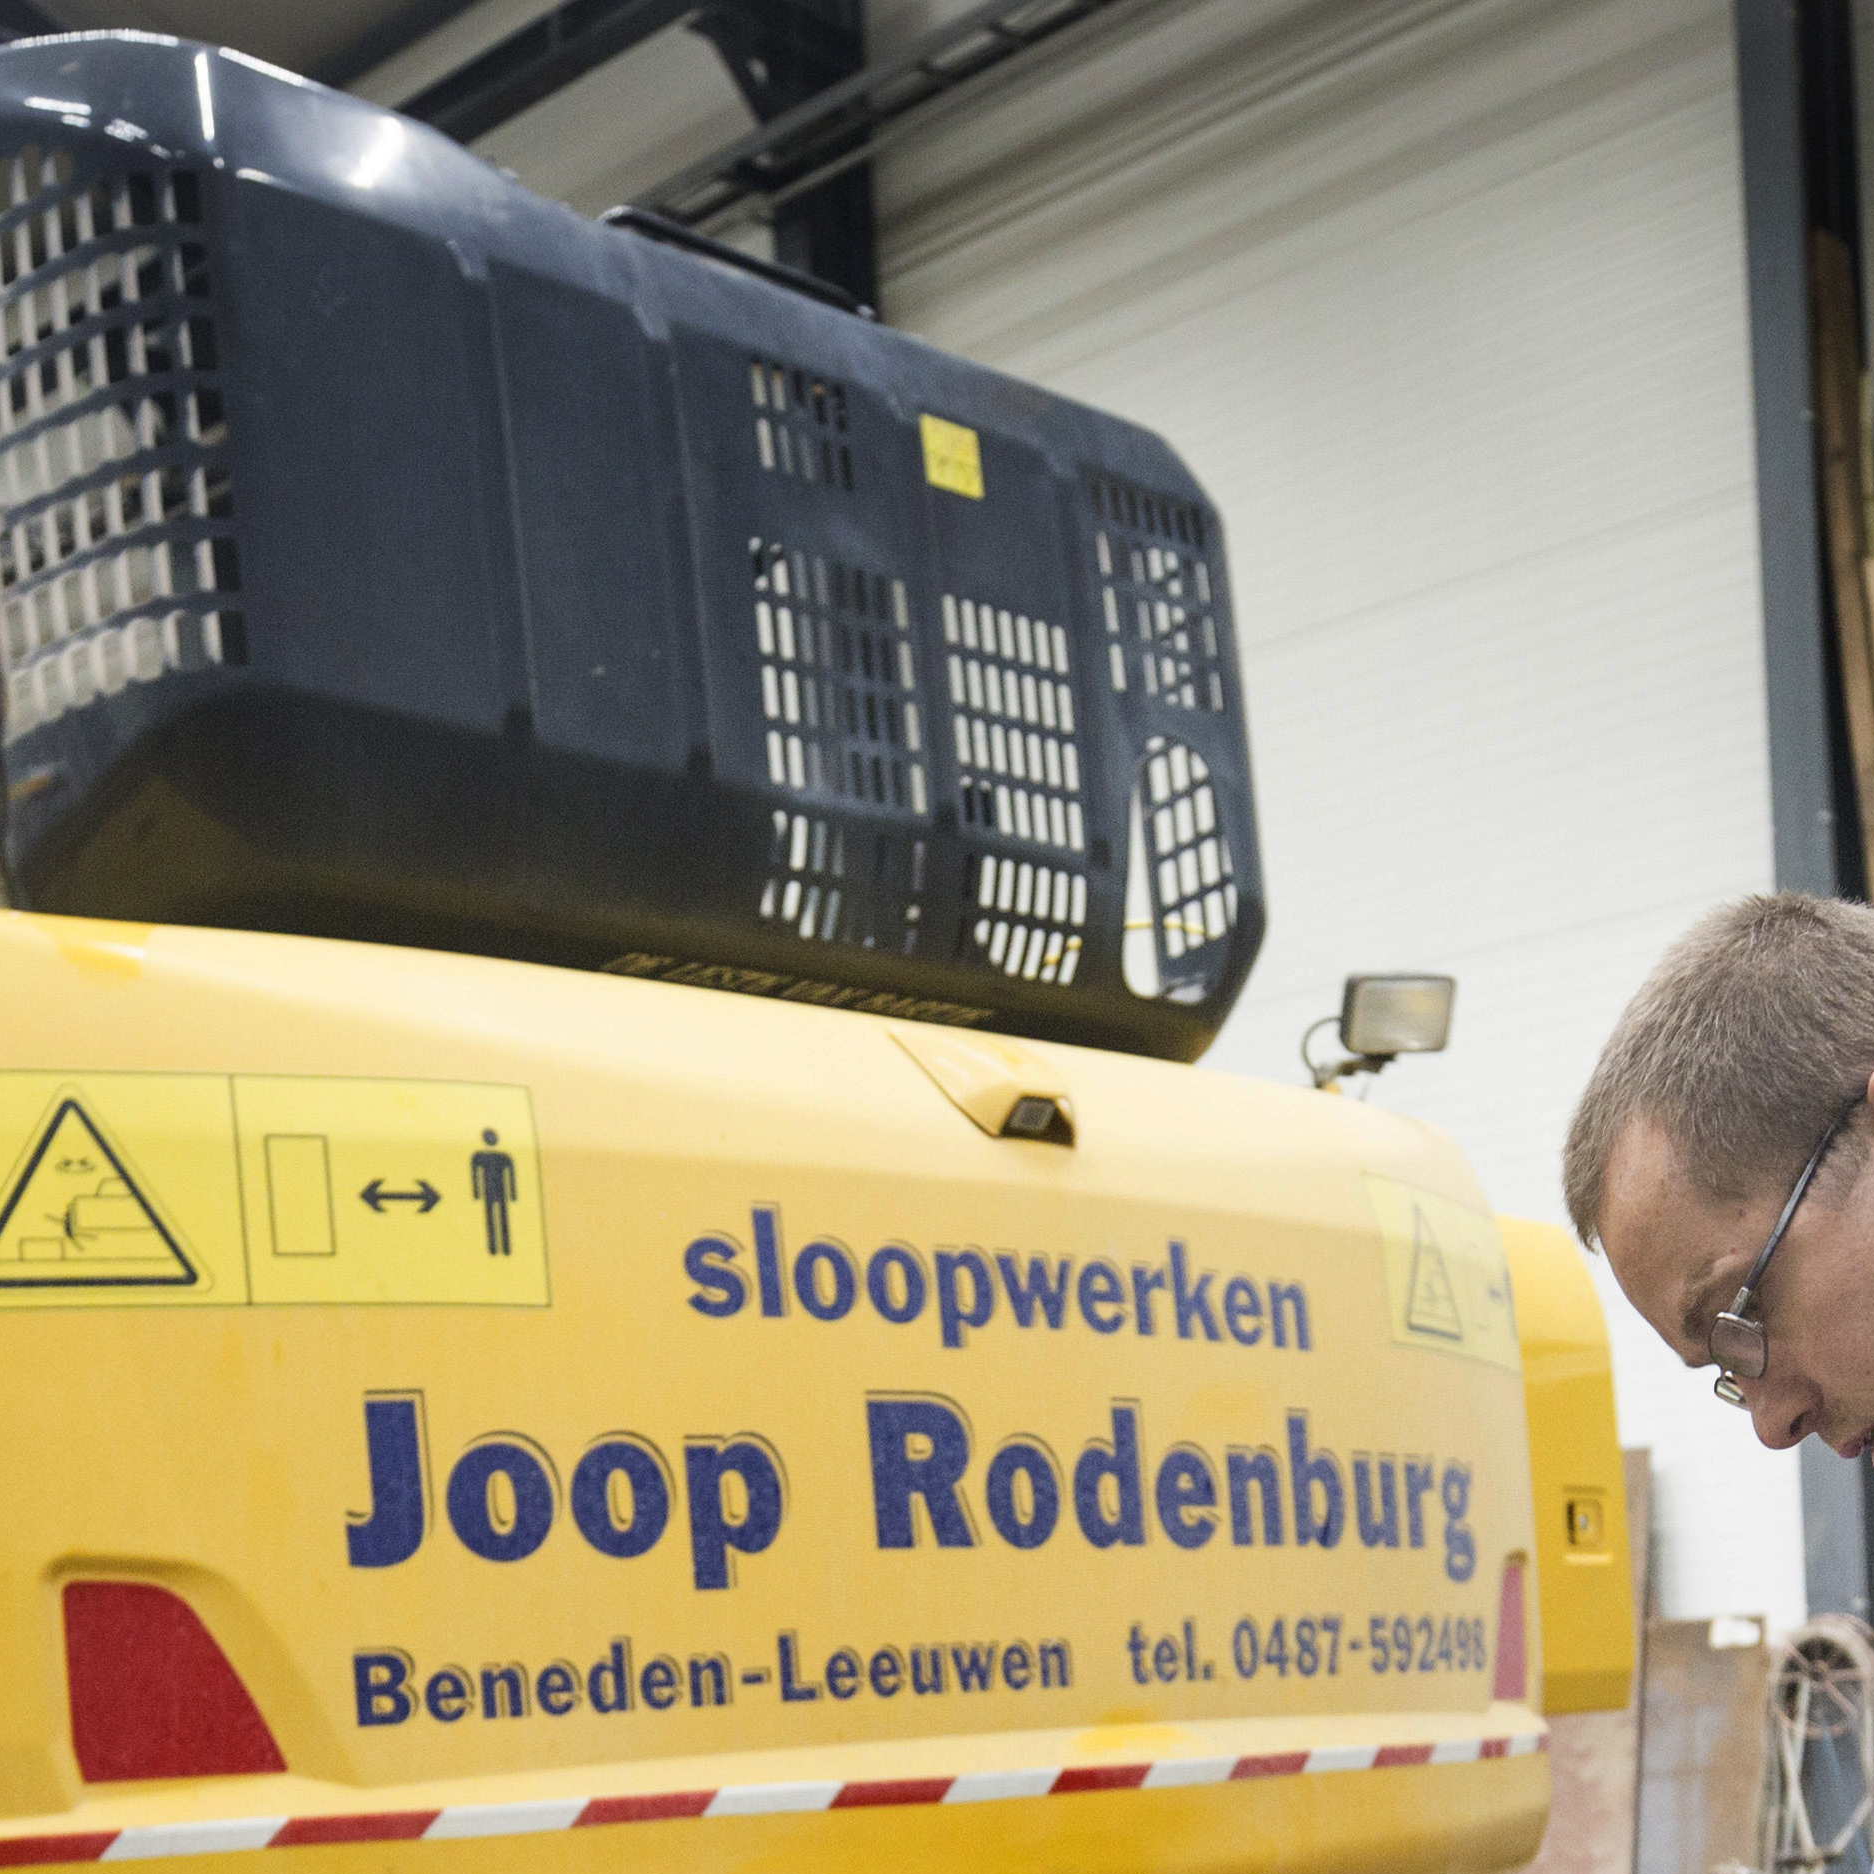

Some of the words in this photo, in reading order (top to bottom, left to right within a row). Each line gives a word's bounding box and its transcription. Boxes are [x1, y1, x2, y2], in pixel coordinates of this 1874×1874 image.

[683, 1201, 1314, 1351] sloopwerken
[345, 1389, 791, 1590] Joop
[864, 1390, 1477, 1582] Rodenburg
[351, 1629, 1073, 1728] Beneden-Leeuwen
[1126, 1616, 1214, 1685] tel.
[1231, 1613, 1487, 1679] 0487-592498
